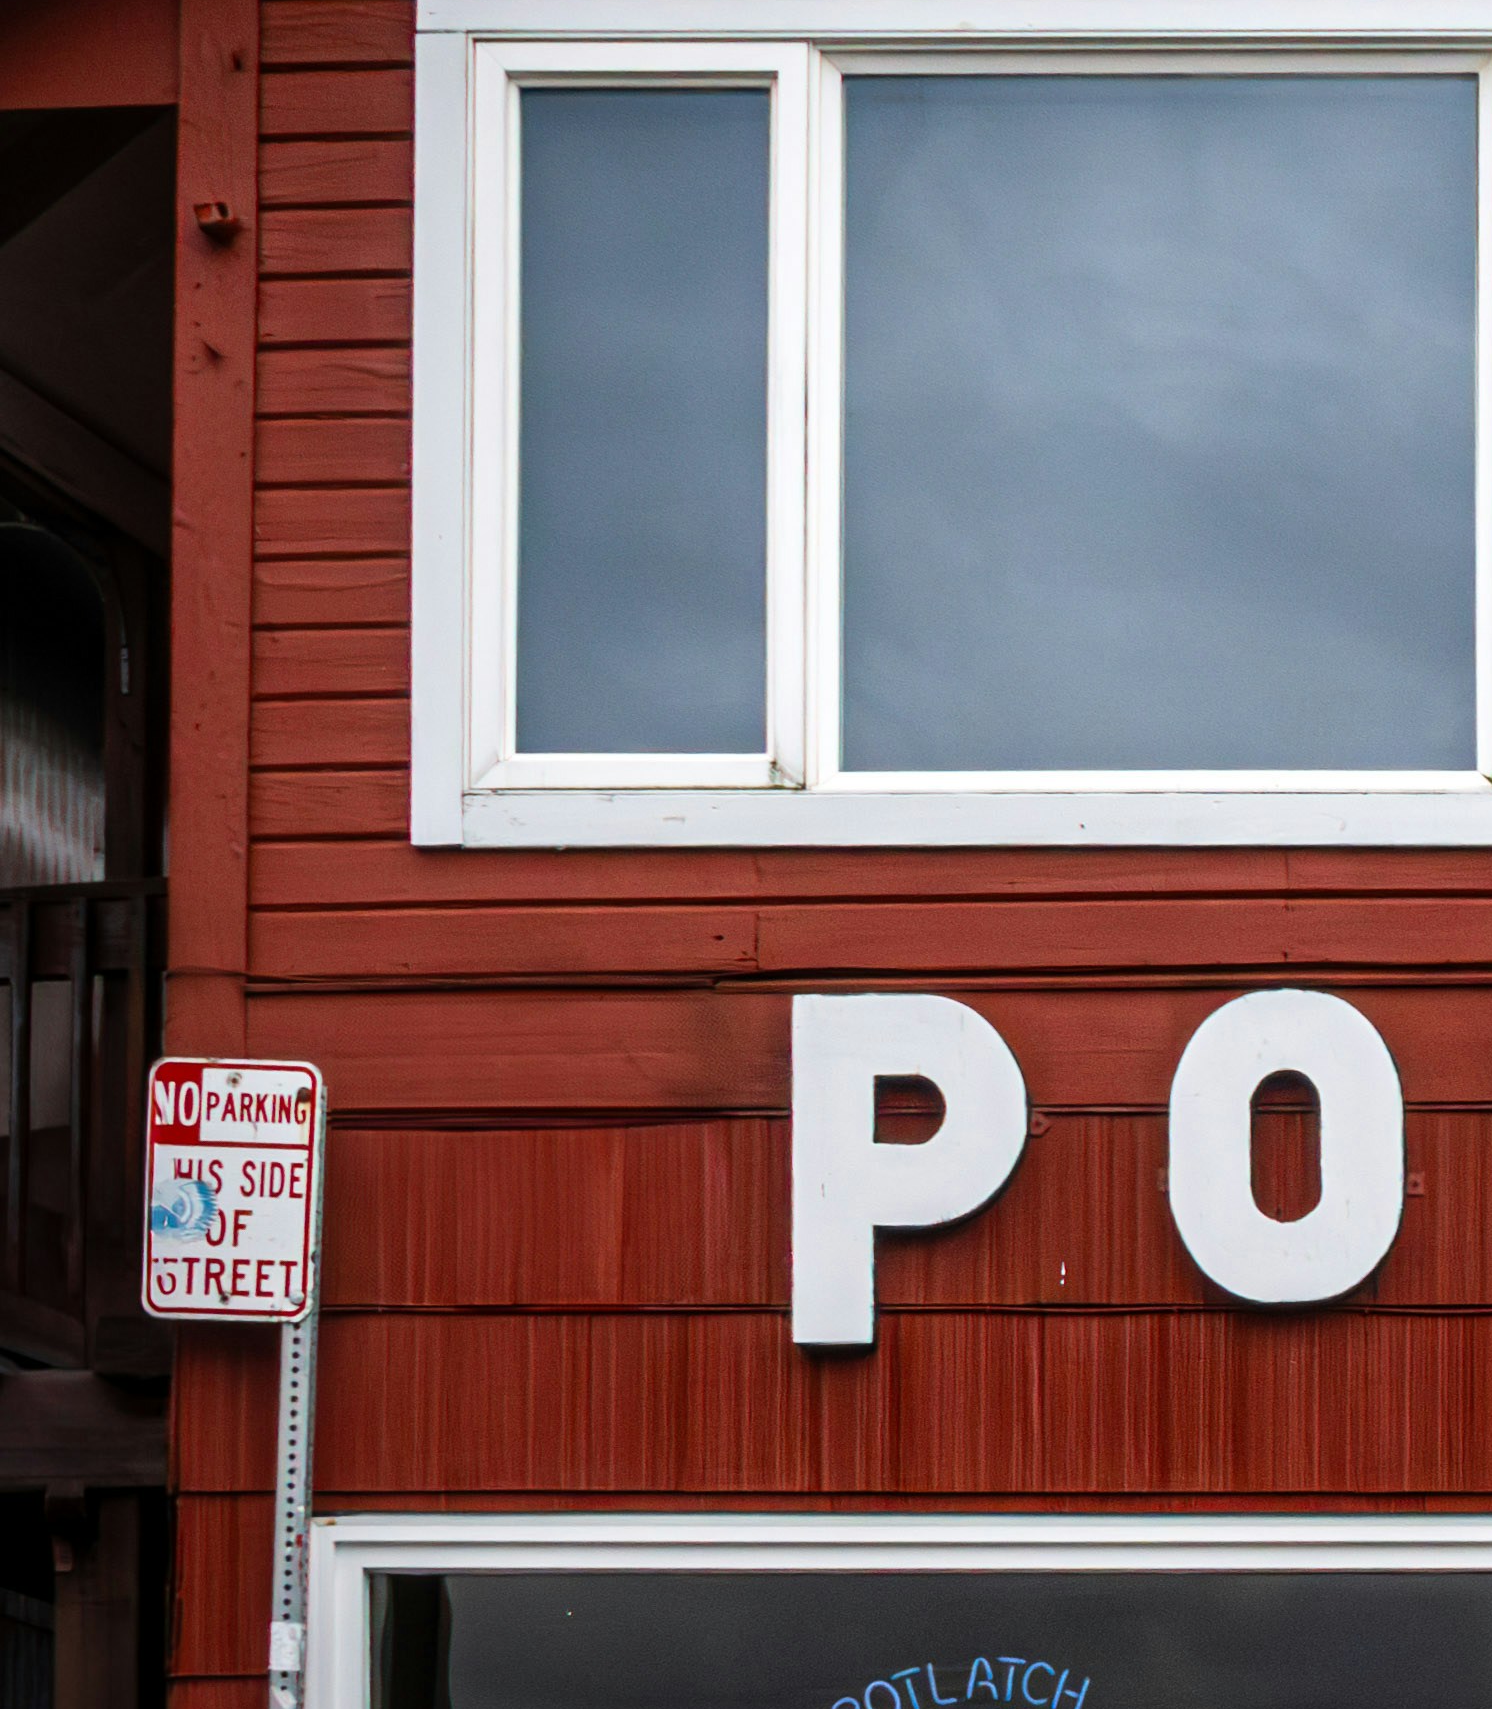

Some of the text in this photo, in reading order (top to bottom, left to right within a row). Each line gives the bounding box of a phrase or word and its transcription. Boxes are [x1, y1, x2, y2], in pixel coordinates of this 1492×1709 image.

[154, 1080, 307, 1127] NO PARKING
[240, 1160, 304, 1199] SIDE
[205, 1208, 253, 1247] OF
[157, 1257, 298, 1297] STREET
